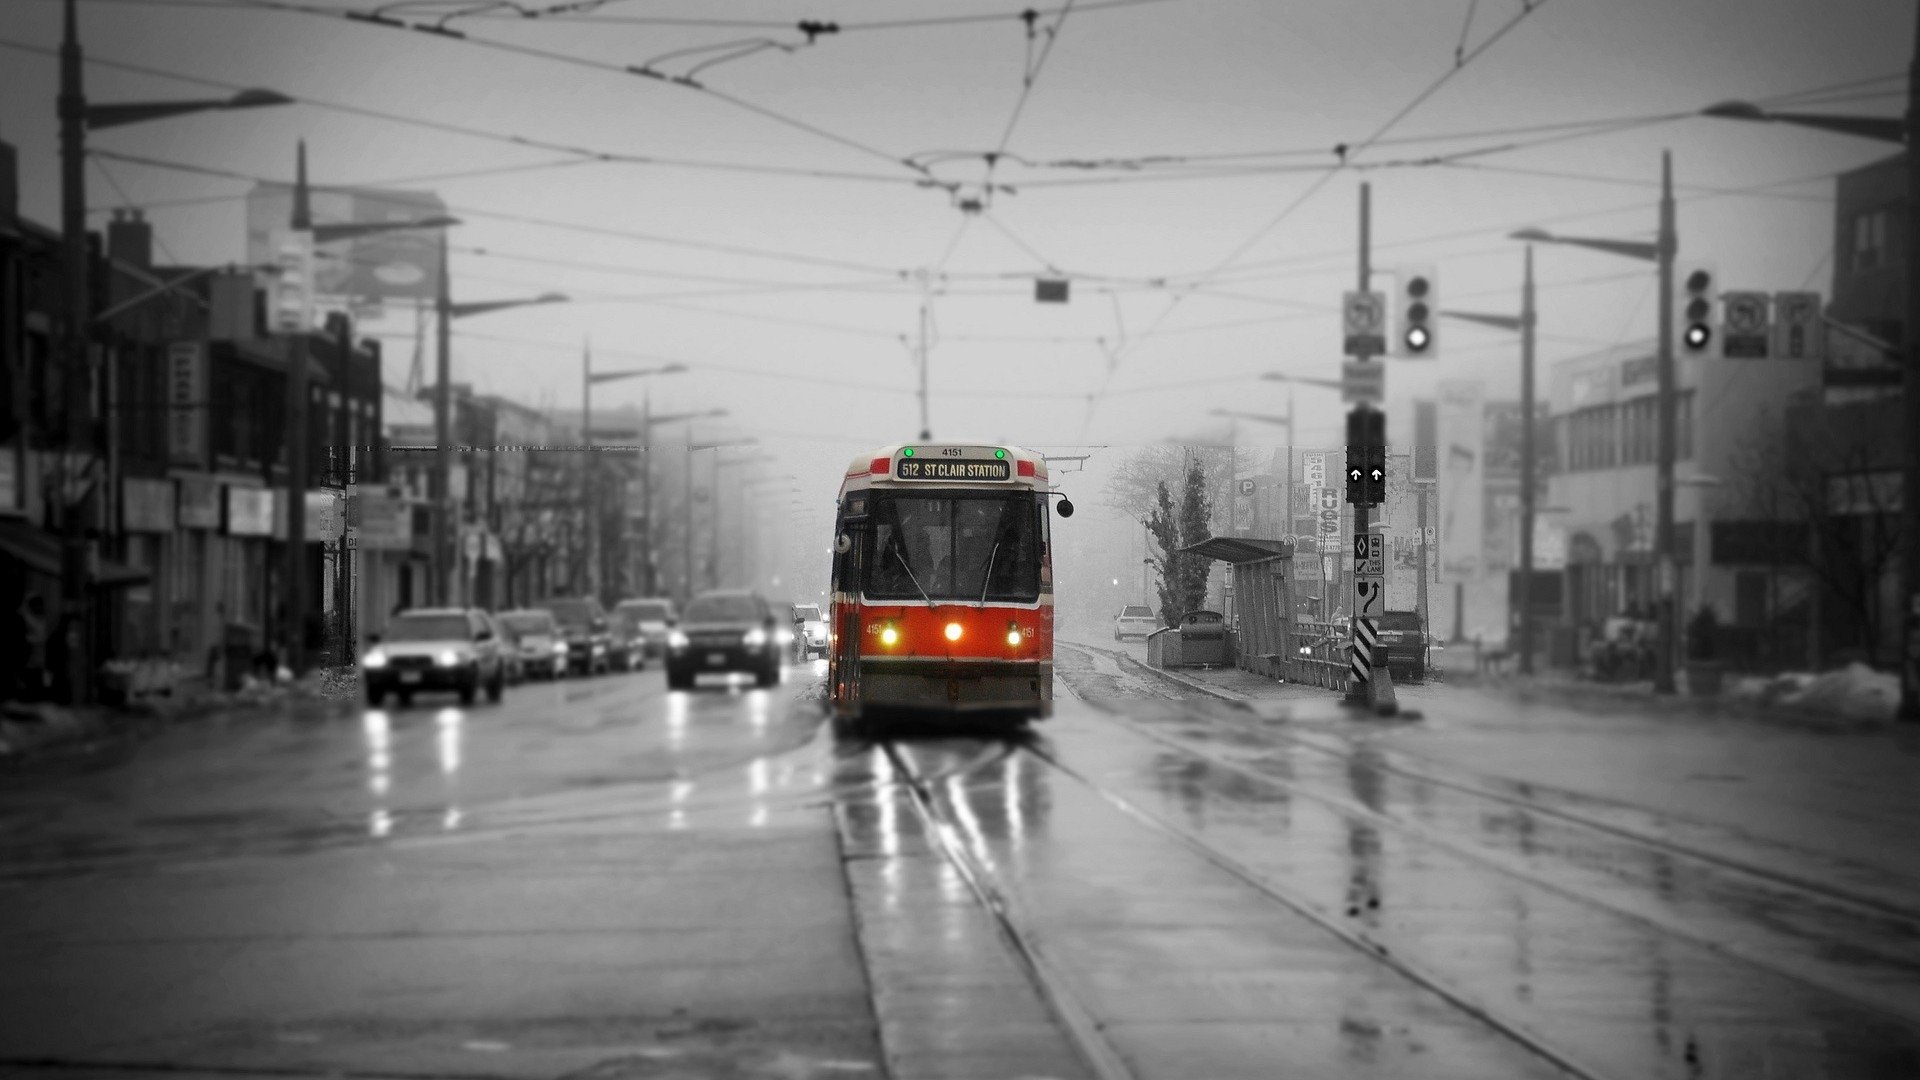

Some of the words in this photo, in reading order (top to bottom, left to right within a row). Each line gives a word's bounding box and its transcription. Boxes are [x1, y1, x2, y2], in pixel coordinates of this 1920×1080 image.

[942, 448, 962, 456] 4151
[903, 464, 919, 476] 512
[925, 464, 936, 476] ST
[938, 464, 965, 477] CLAIR
[967, 464, 1006, 477] STATION
[1243, 481, 1253, 491] P
[1321, 489, 1338, 532] RUGS
